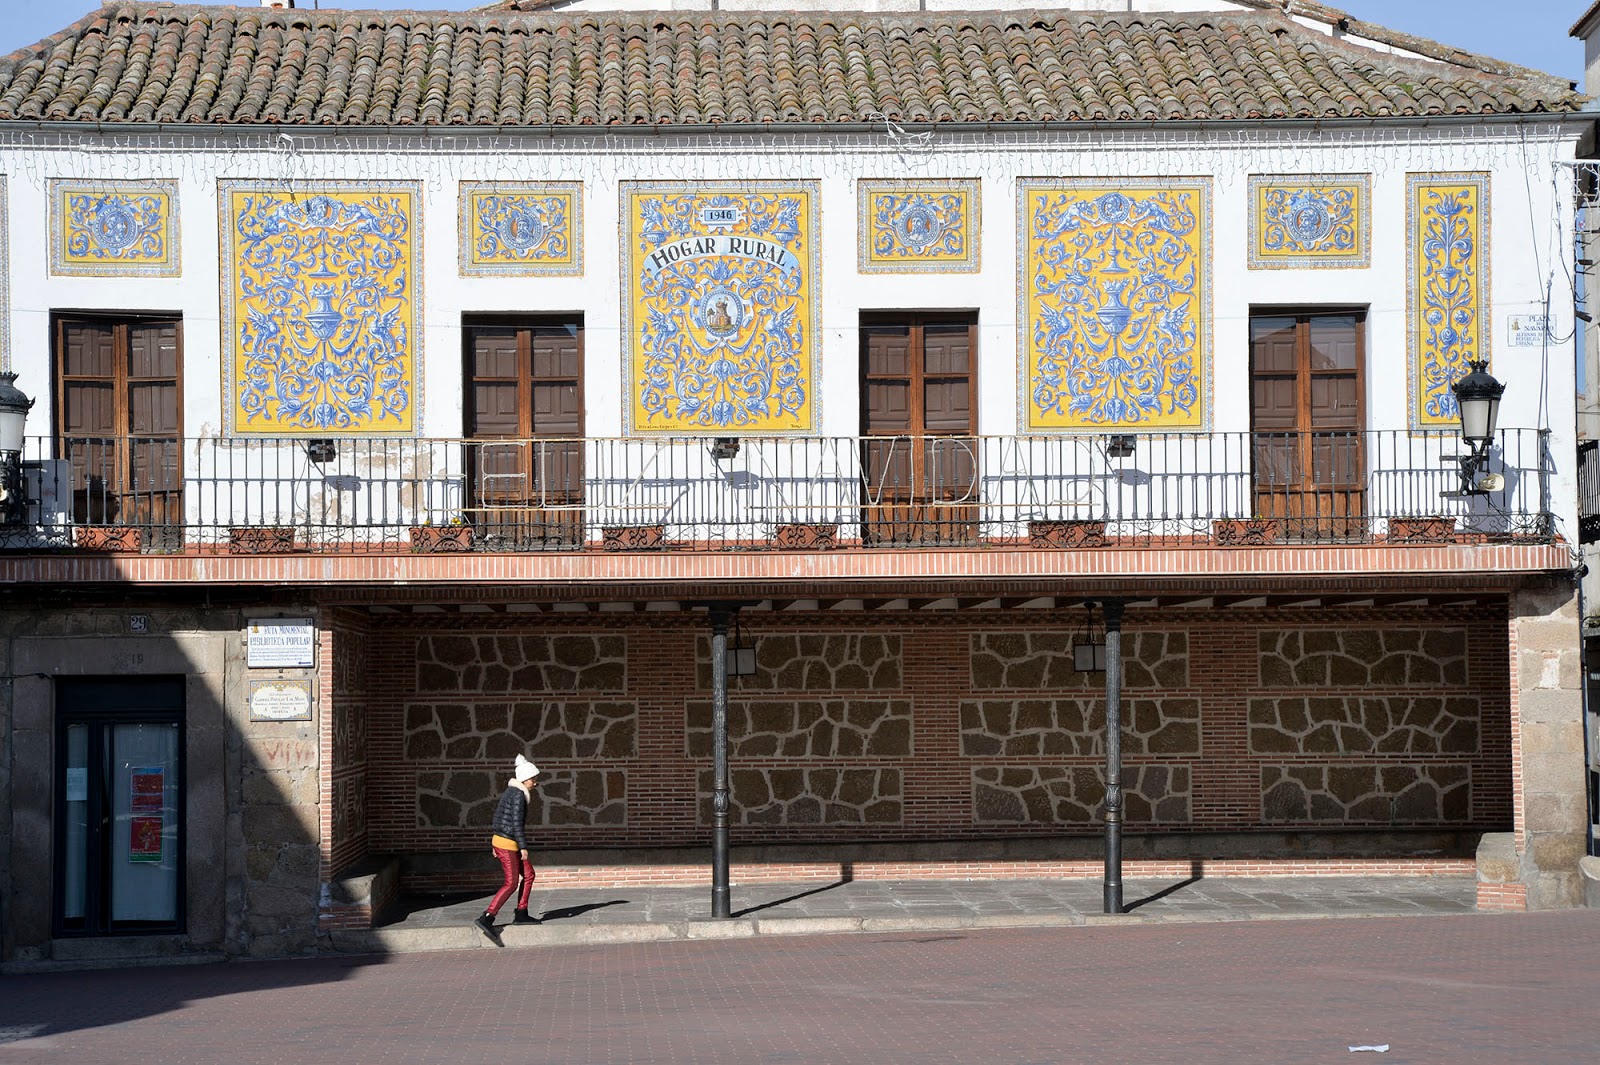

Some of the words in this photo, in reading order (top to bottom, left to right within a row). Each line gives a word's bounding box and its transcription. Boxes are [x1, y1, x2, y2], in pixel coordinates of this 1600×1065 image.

[709, 210, 732, 220] 1946
[650, 237, 716, 269] HOGAR
[729, 237, 787, 267] RURAL
[131, 616, 146, 631] 29
[250, 637, 285, 646] BIBLIOTECA
[286, 636, 311, 646] POPULAR
